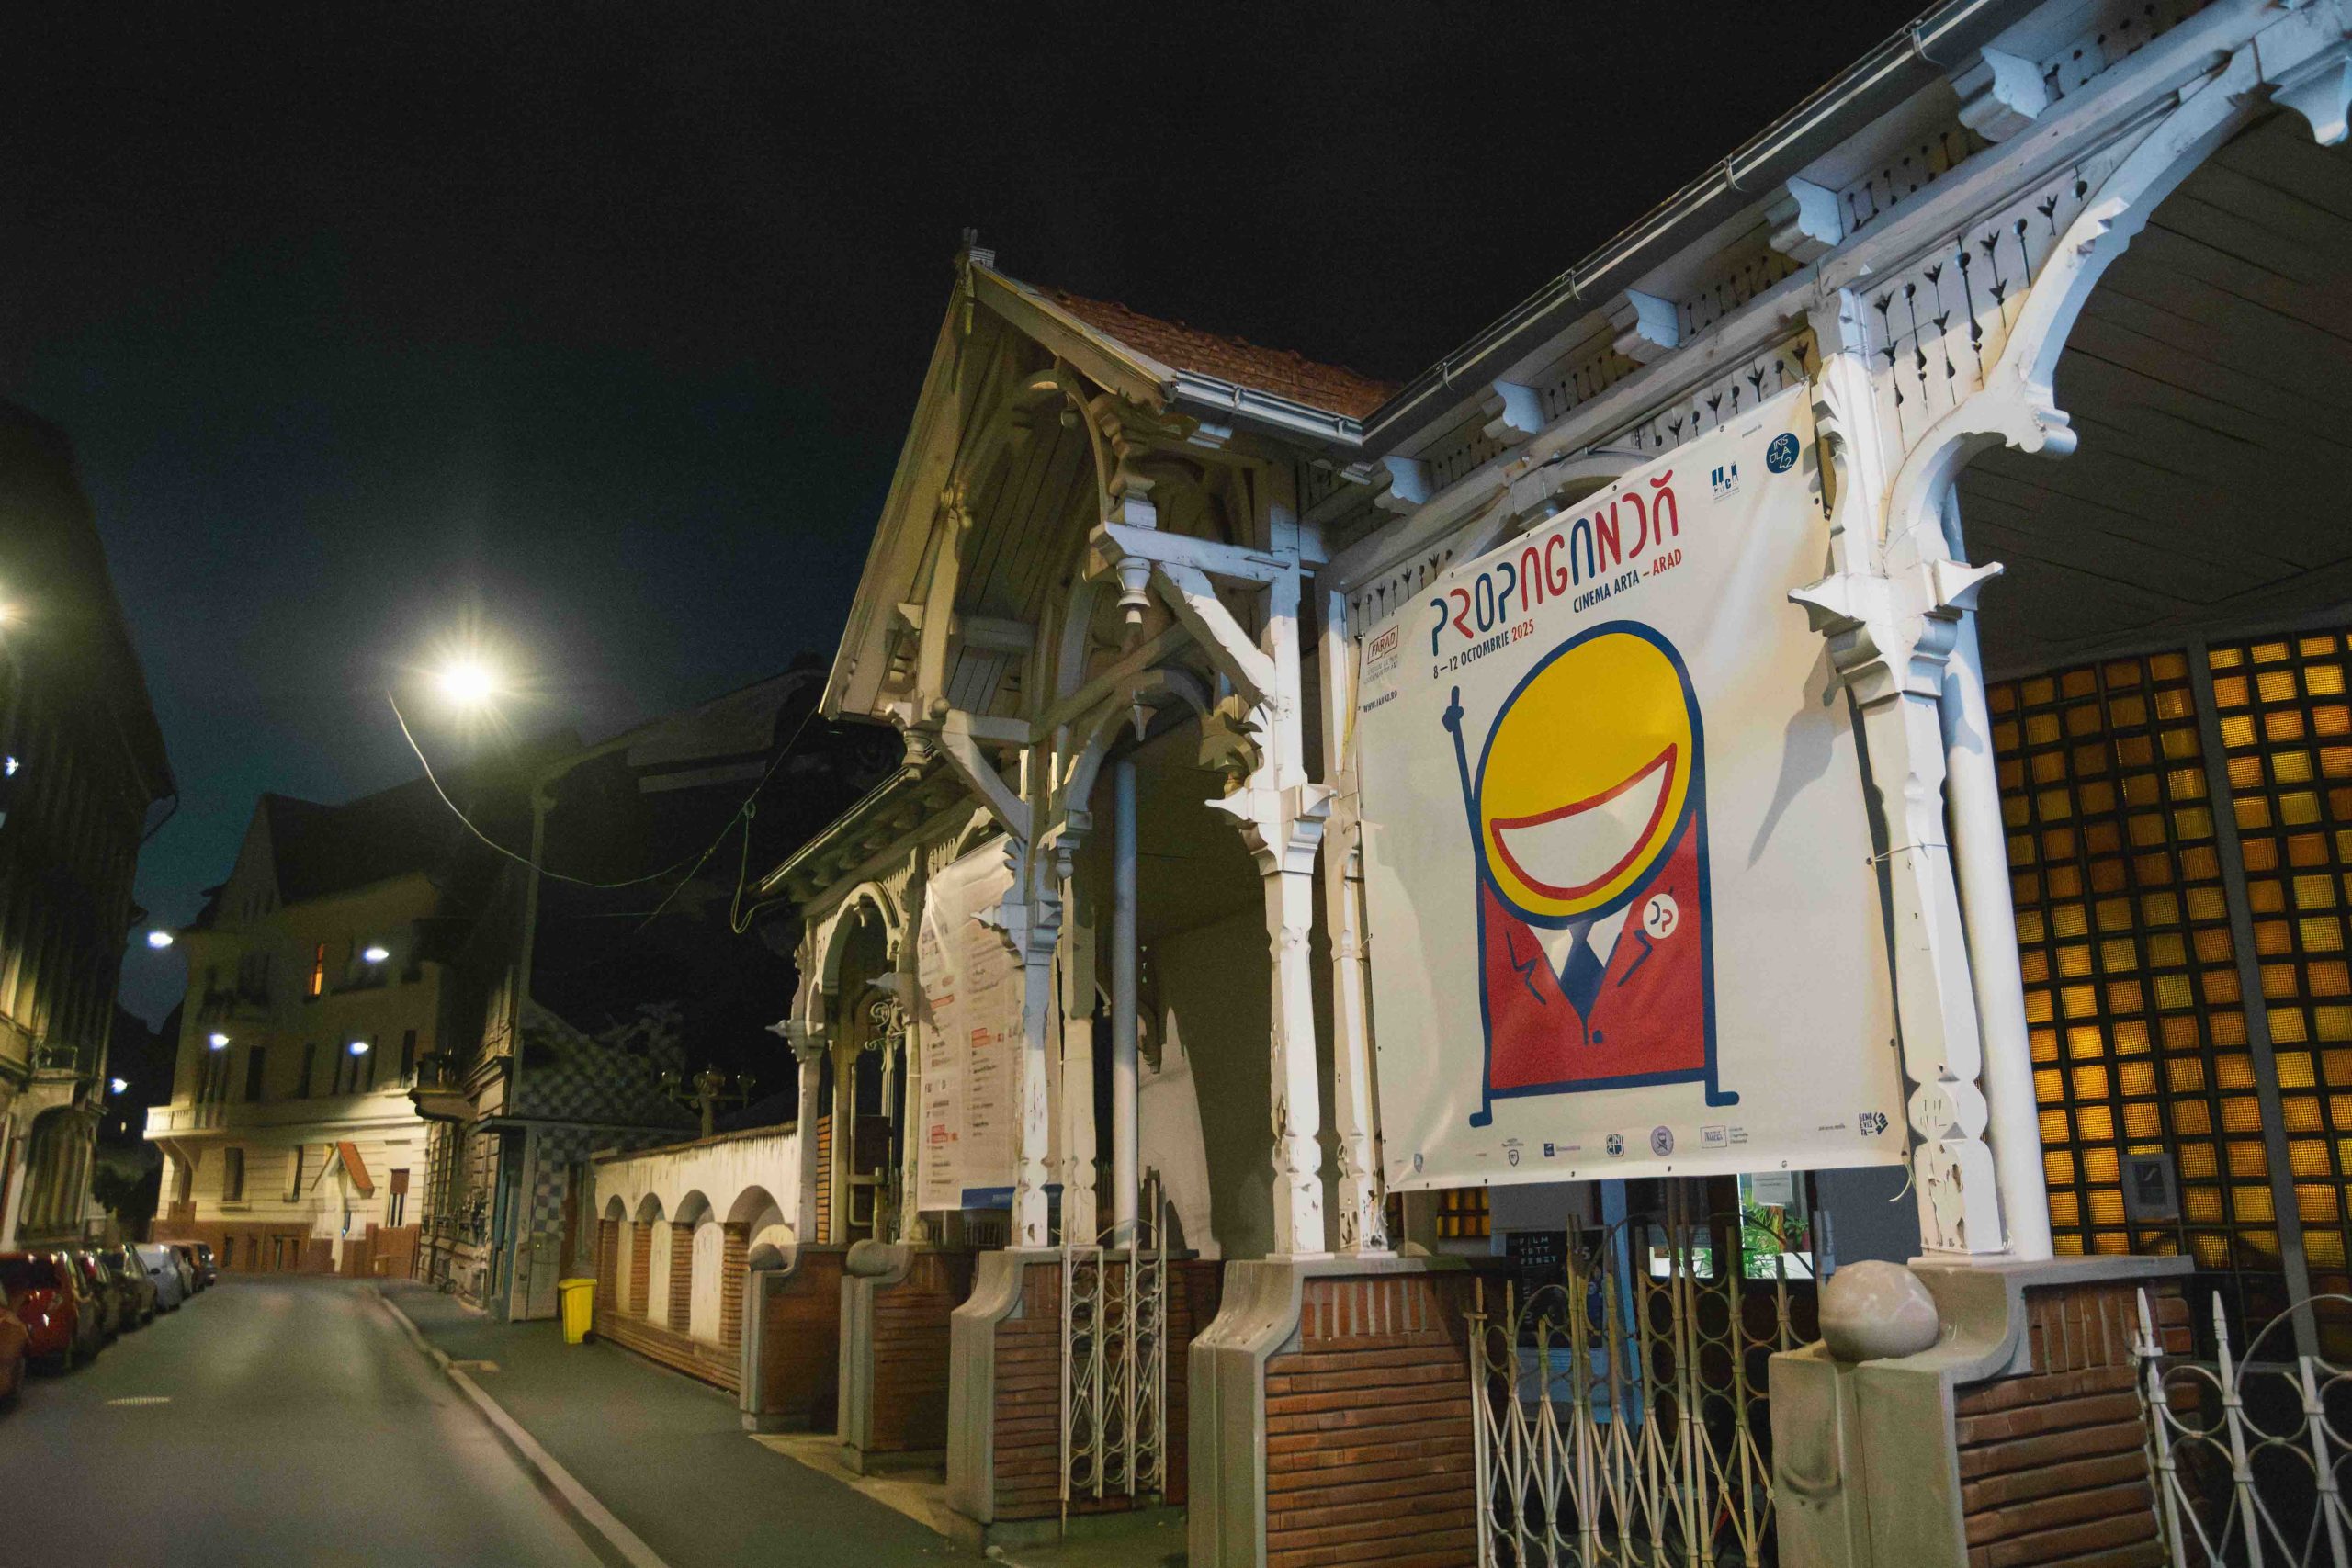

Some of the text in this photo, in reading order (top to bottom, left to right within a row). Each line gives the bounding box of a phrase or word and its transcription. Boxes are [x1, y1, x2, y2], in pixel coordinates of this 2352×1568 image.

[1430, 469, 1679, 656] PROPAGANDĂ
[1573, 582, 1611, 613] CINEMA
[1614, 569, 1640, 595] ARTA
[1652, 548, 1682, 576] ARAD
[1461, 630, 1510, 666] OCTOMBRIE
[1511, 618, 1534, 643] 2025
